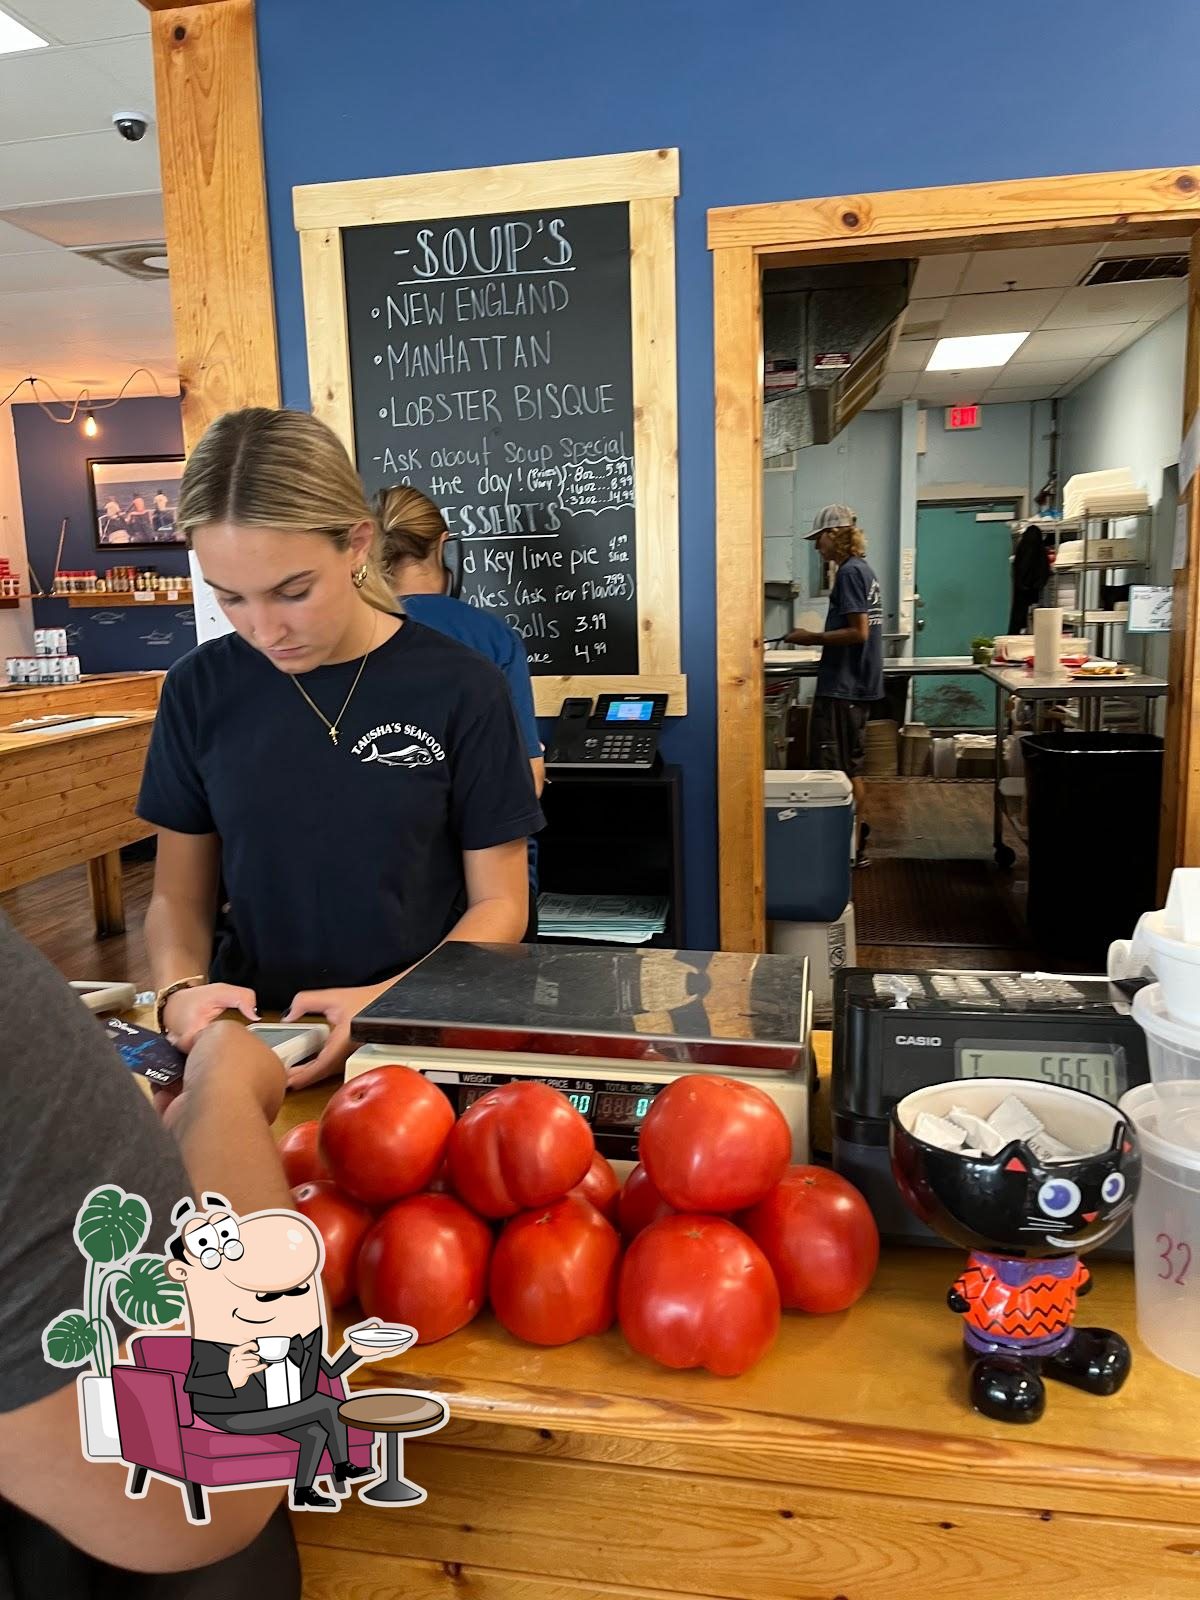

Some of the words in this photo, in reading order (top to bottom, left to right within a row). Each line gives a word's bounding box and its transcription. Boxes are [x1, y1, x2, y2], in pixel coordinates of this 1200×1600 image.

[386, 292, 445, 329] NEW
[456, 280, 569, 323] ENGLAND
[386, 331, 551, 381] MANHATTAN
[390, 388, 501, 427] LOBSTER
[514, 383, 615, 423] BISQUE
[430, 437, 491, 467] about
[504, 441, 553, 469] Soup
[560, 431, 625, 464] Special
[429, 475, 464, 495] the
[440, 501, 561, 537] ESSERT'S
[570, 547, 600, 575] pie
[462, 584, 509, 609] akes
[574, 612, 607, 633] 3.99
[526, 652, 553, 664] ake
[350, 722, 402, 755] TAUSHA'S
[403, 724, 446, 761] SEAFOOD
[108, 1018, 140, 1036] Disney
[895, 1035, 942, 1047] CASIO
[144, 1068, 171, 1082] VISA
[462, 1074, 493, 1084] WEIGHT
[604, 1082, 629, 1093] TOTAL
[1155, 1233, 1192, 1286] 32
